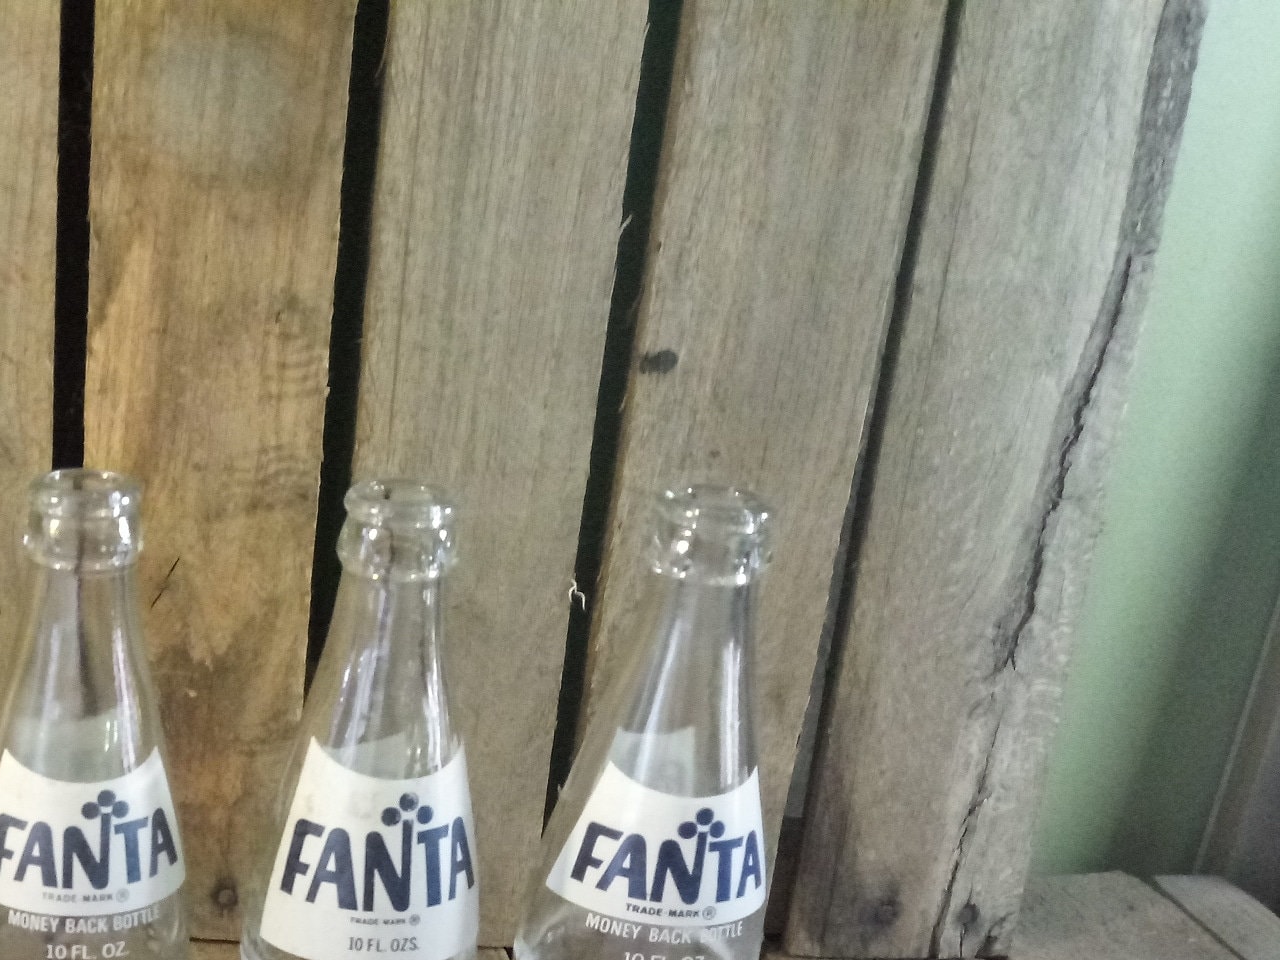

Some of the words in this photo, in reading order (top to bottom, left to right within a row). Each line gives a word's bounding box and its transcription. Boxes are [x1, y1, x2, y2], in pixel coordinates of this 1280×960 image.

[280, 816, 475, 912] FANTA
[570, 821, 762, 905] FANTA
[42, 891, 76, 902] TRADE
[82, 893, 113, 902] MARK
[8, 909, 59, 934] MONEY
[65, 917, 108, 934] BACK
[113, 902, 160, 932] BOTTLE
[625, 902, 662, 917] TRADE
[668, 908, 699, 918] MARK
[585, 912, 642, 940] MONEY
[648, 927, 692, 945] BACK
[46, 943, 67, 960] 10
[349, 936, 363, 951] 10
